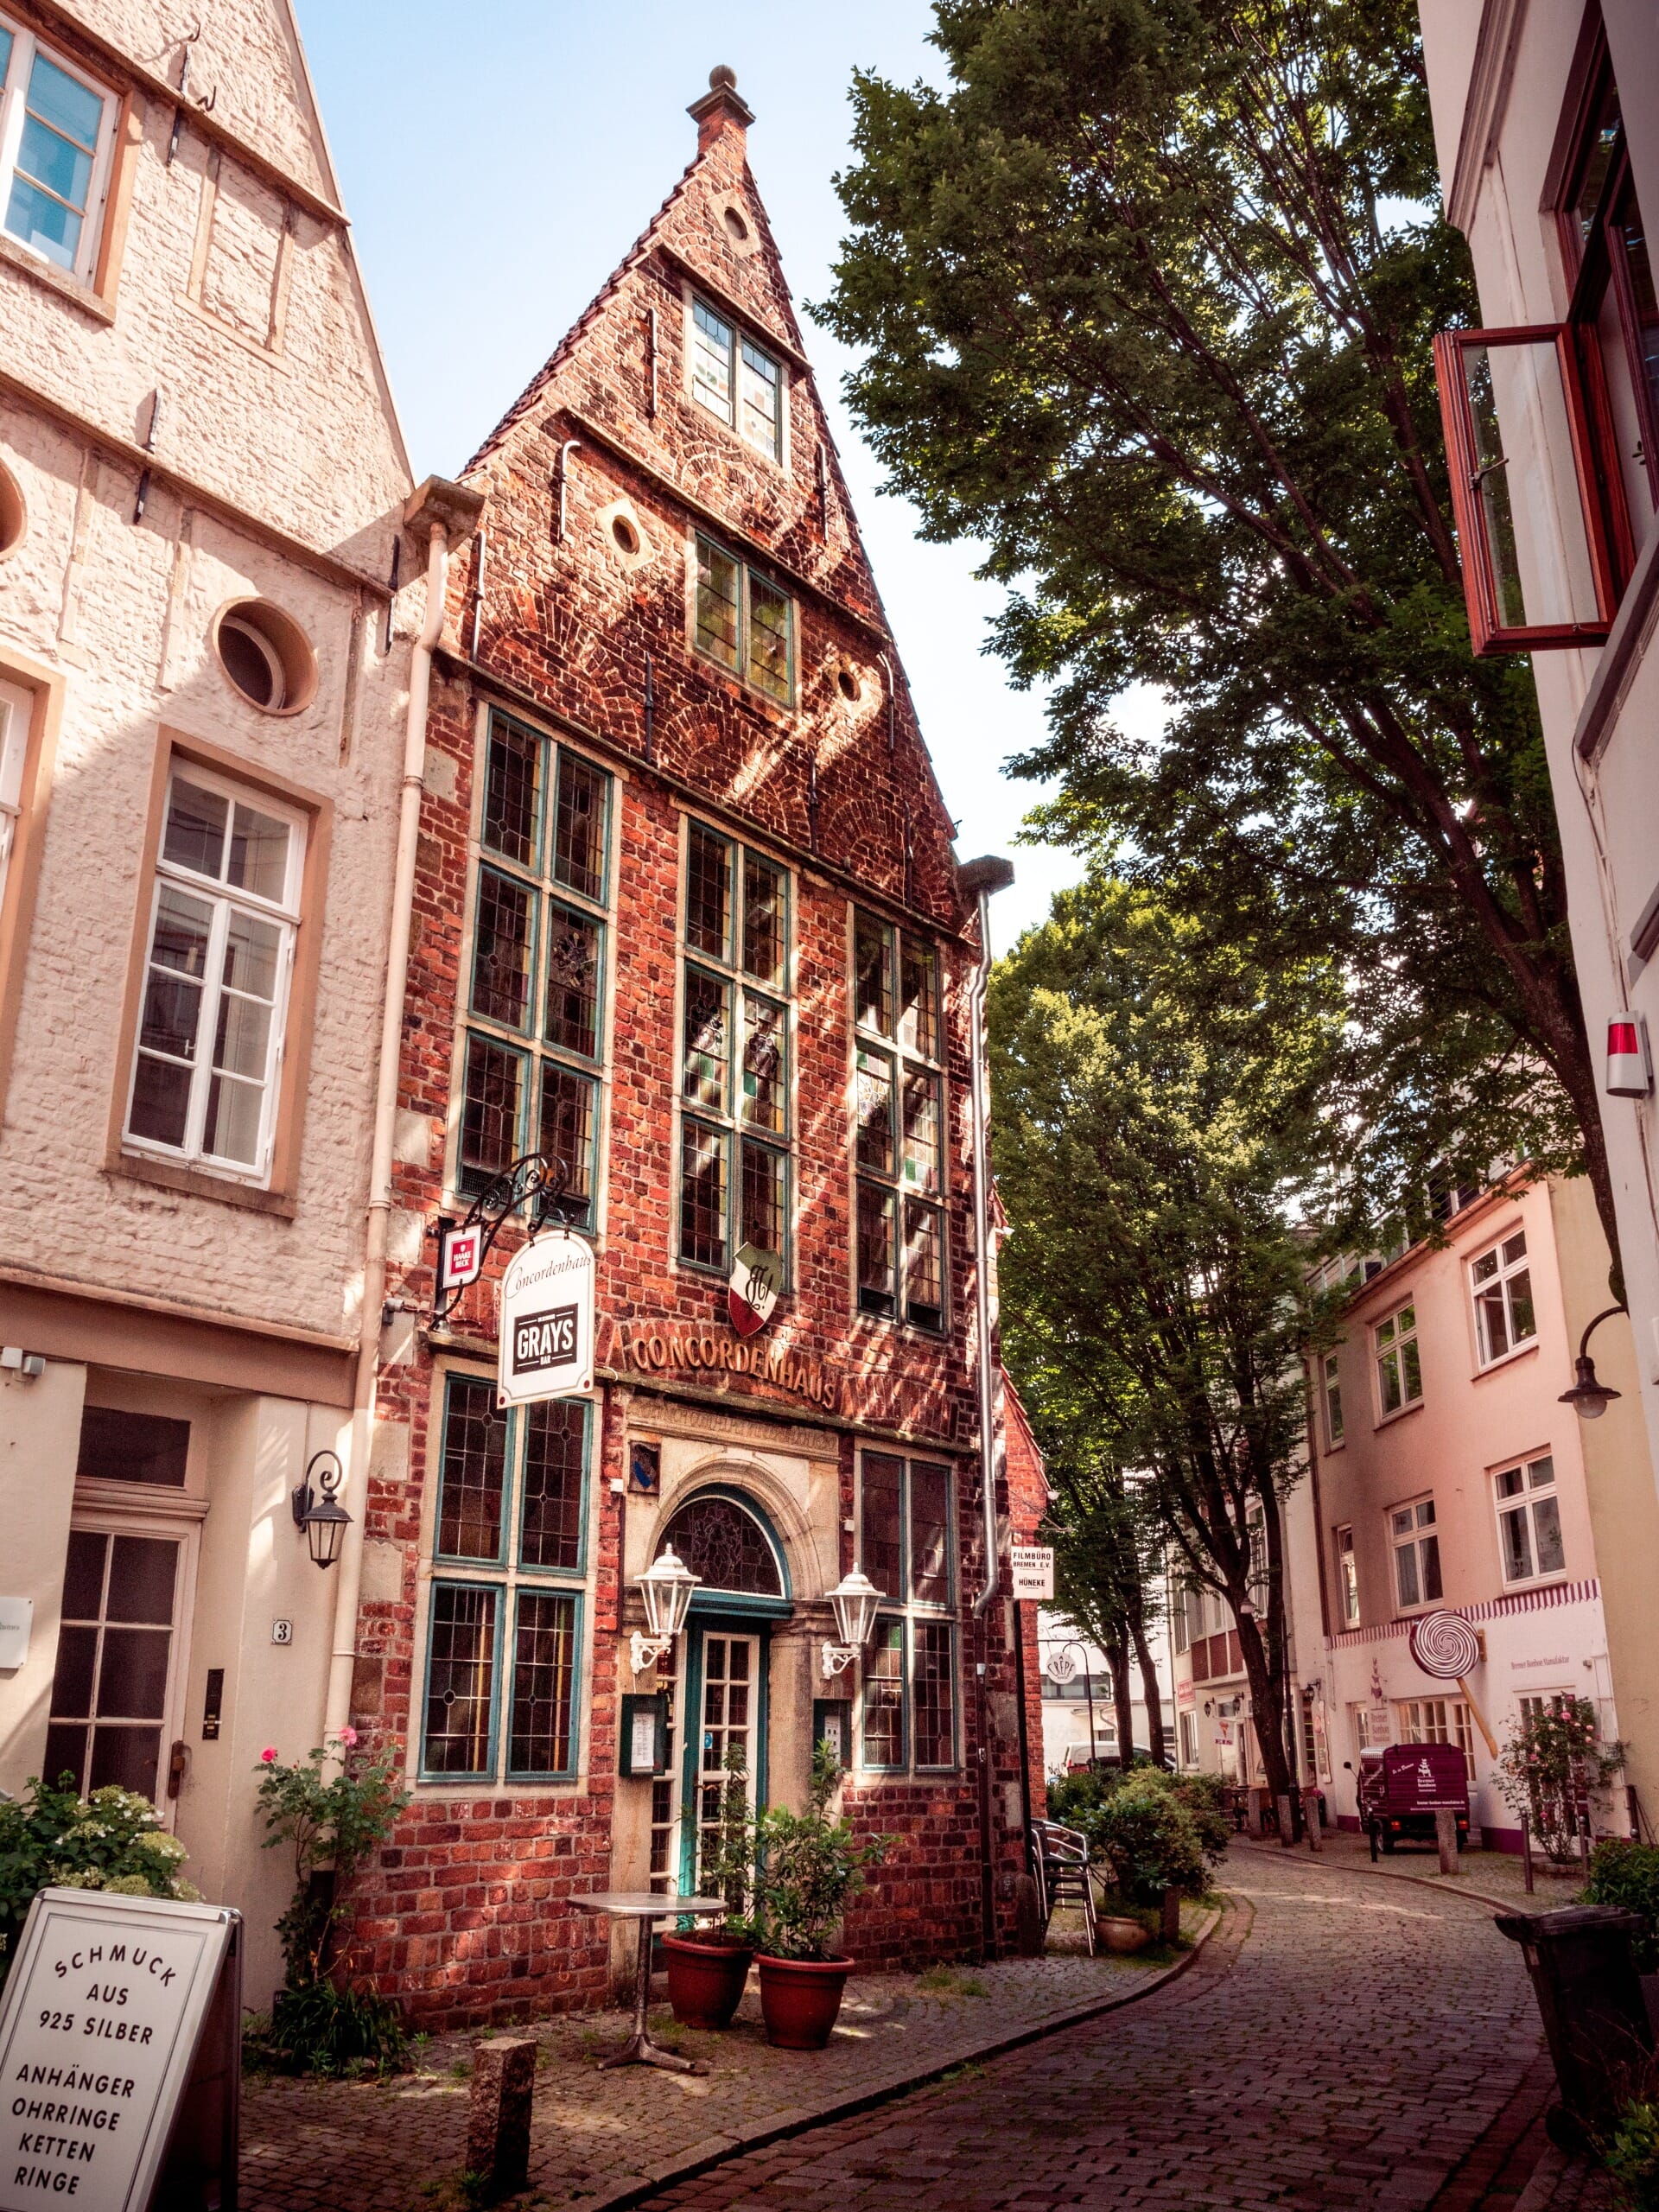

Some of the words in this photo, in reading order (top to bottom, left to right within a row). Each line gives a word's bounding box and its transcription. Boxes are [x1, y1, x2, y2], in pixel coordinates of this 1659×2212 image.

[453, 1250, 472, 1262] HAAKE
[504, 1255, 593, 1300] Concordenhaus
[518, 1319, 574, 1360] GRAYS
[540, 1355, 551, 1365] BAR
[632, 1336, 836, 1410] CONCORDENHAUS
[1013, 1551, 1052, 1560] FILMBÜRO
[1019, 1577, 1046, 1587] HÜNEKE
[277, 1623, 288, 1641] 3
[54, 1944, 176, 1987] SCHMUCK
[86, 1983, 130, 2005] AUS
[39, 2010, 75, 2031] 925
[83, 2017, 153, 2045] SILBER
[16, 2063, 135, 2098] ANHÄNGER
[12, 2097, 121, 2132] OHRRINGE
[18, 2133, 96, 2163] KETTEN
[14, 2166, 80, 2196] RINGE
